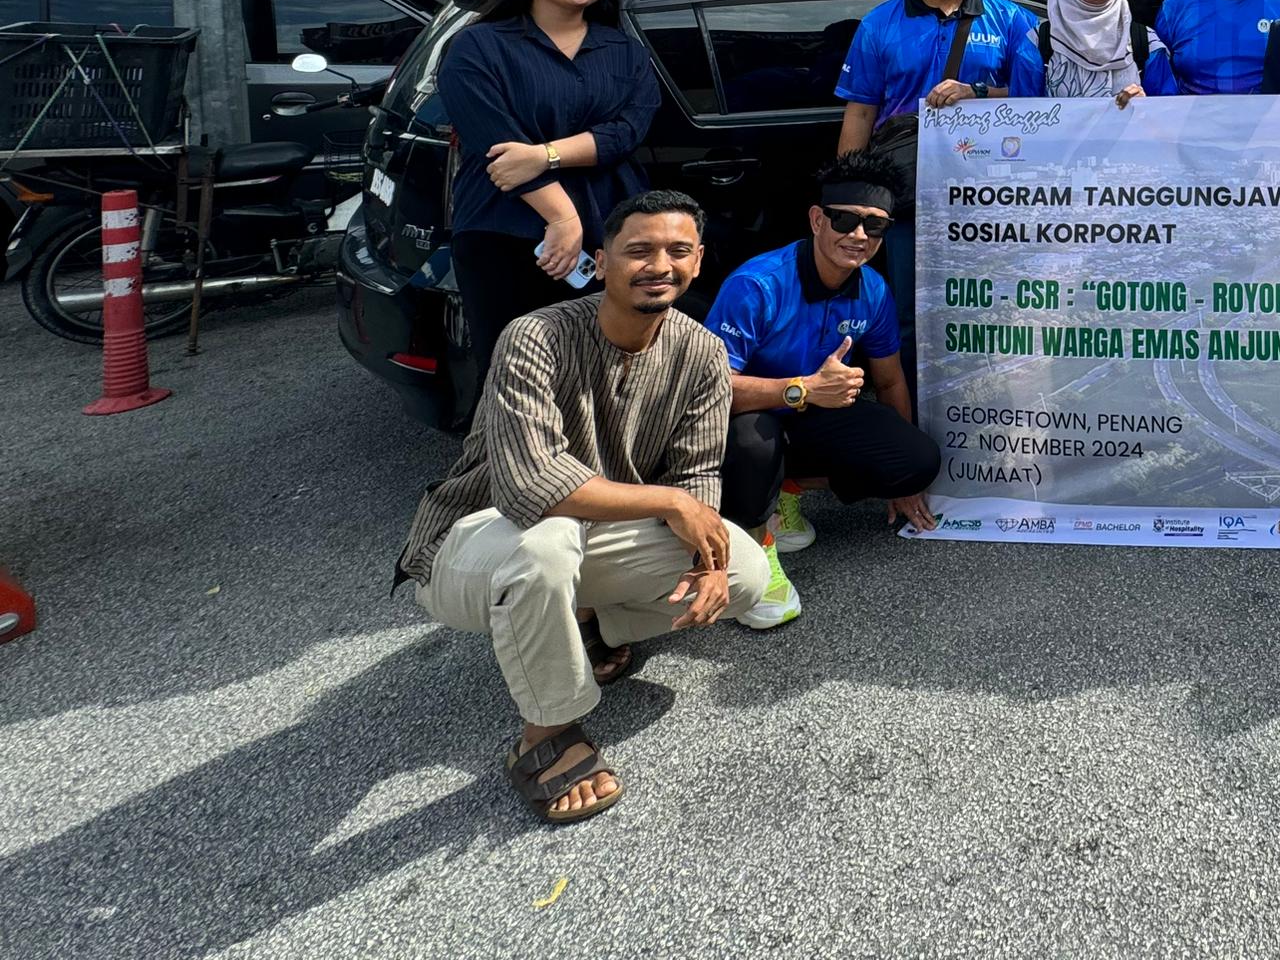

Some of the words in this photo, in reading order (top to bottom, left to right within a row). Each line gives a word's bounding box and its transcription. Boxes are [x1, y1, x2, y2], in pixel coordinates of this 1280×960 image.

[970, 32, 1000, 44] UUM
[924, 106, 991, 134] Anjung
[993, 103, 1061, 135] Singgah
[948, 186, 1072, 207] PROGRAM
[947, 222, 1031, 243] SOSIAL
[1037, 223, 1177, 244] KORPORAT
[945, 278, 993, 308] CIAC
[1016, 279, 1059, 310] CSR
[945, 323, 1034, 356] SANTUNI
[1042, 326, 1124, 358] WARGA
[1132, 329, 1200, 360] EMAS
[946, 405, 1092, 434] GEORGETOWN,
[1097, 412, 1183, 434] PENANG
[946, 433, 968, 449] 22
[979, 433, 1085, 457] NOVEMBER
[1092, 441, 1144, 458] 2024
[946, 457, 1042, 486] (JUMAAT)
[1018, 518, 1055, 530] AMBA
[1096, 523, 1141, 532] BACHELOR
[1169, 525, 1204, 533] Hospitality
[1219, 516, 1245, 528] IQA
